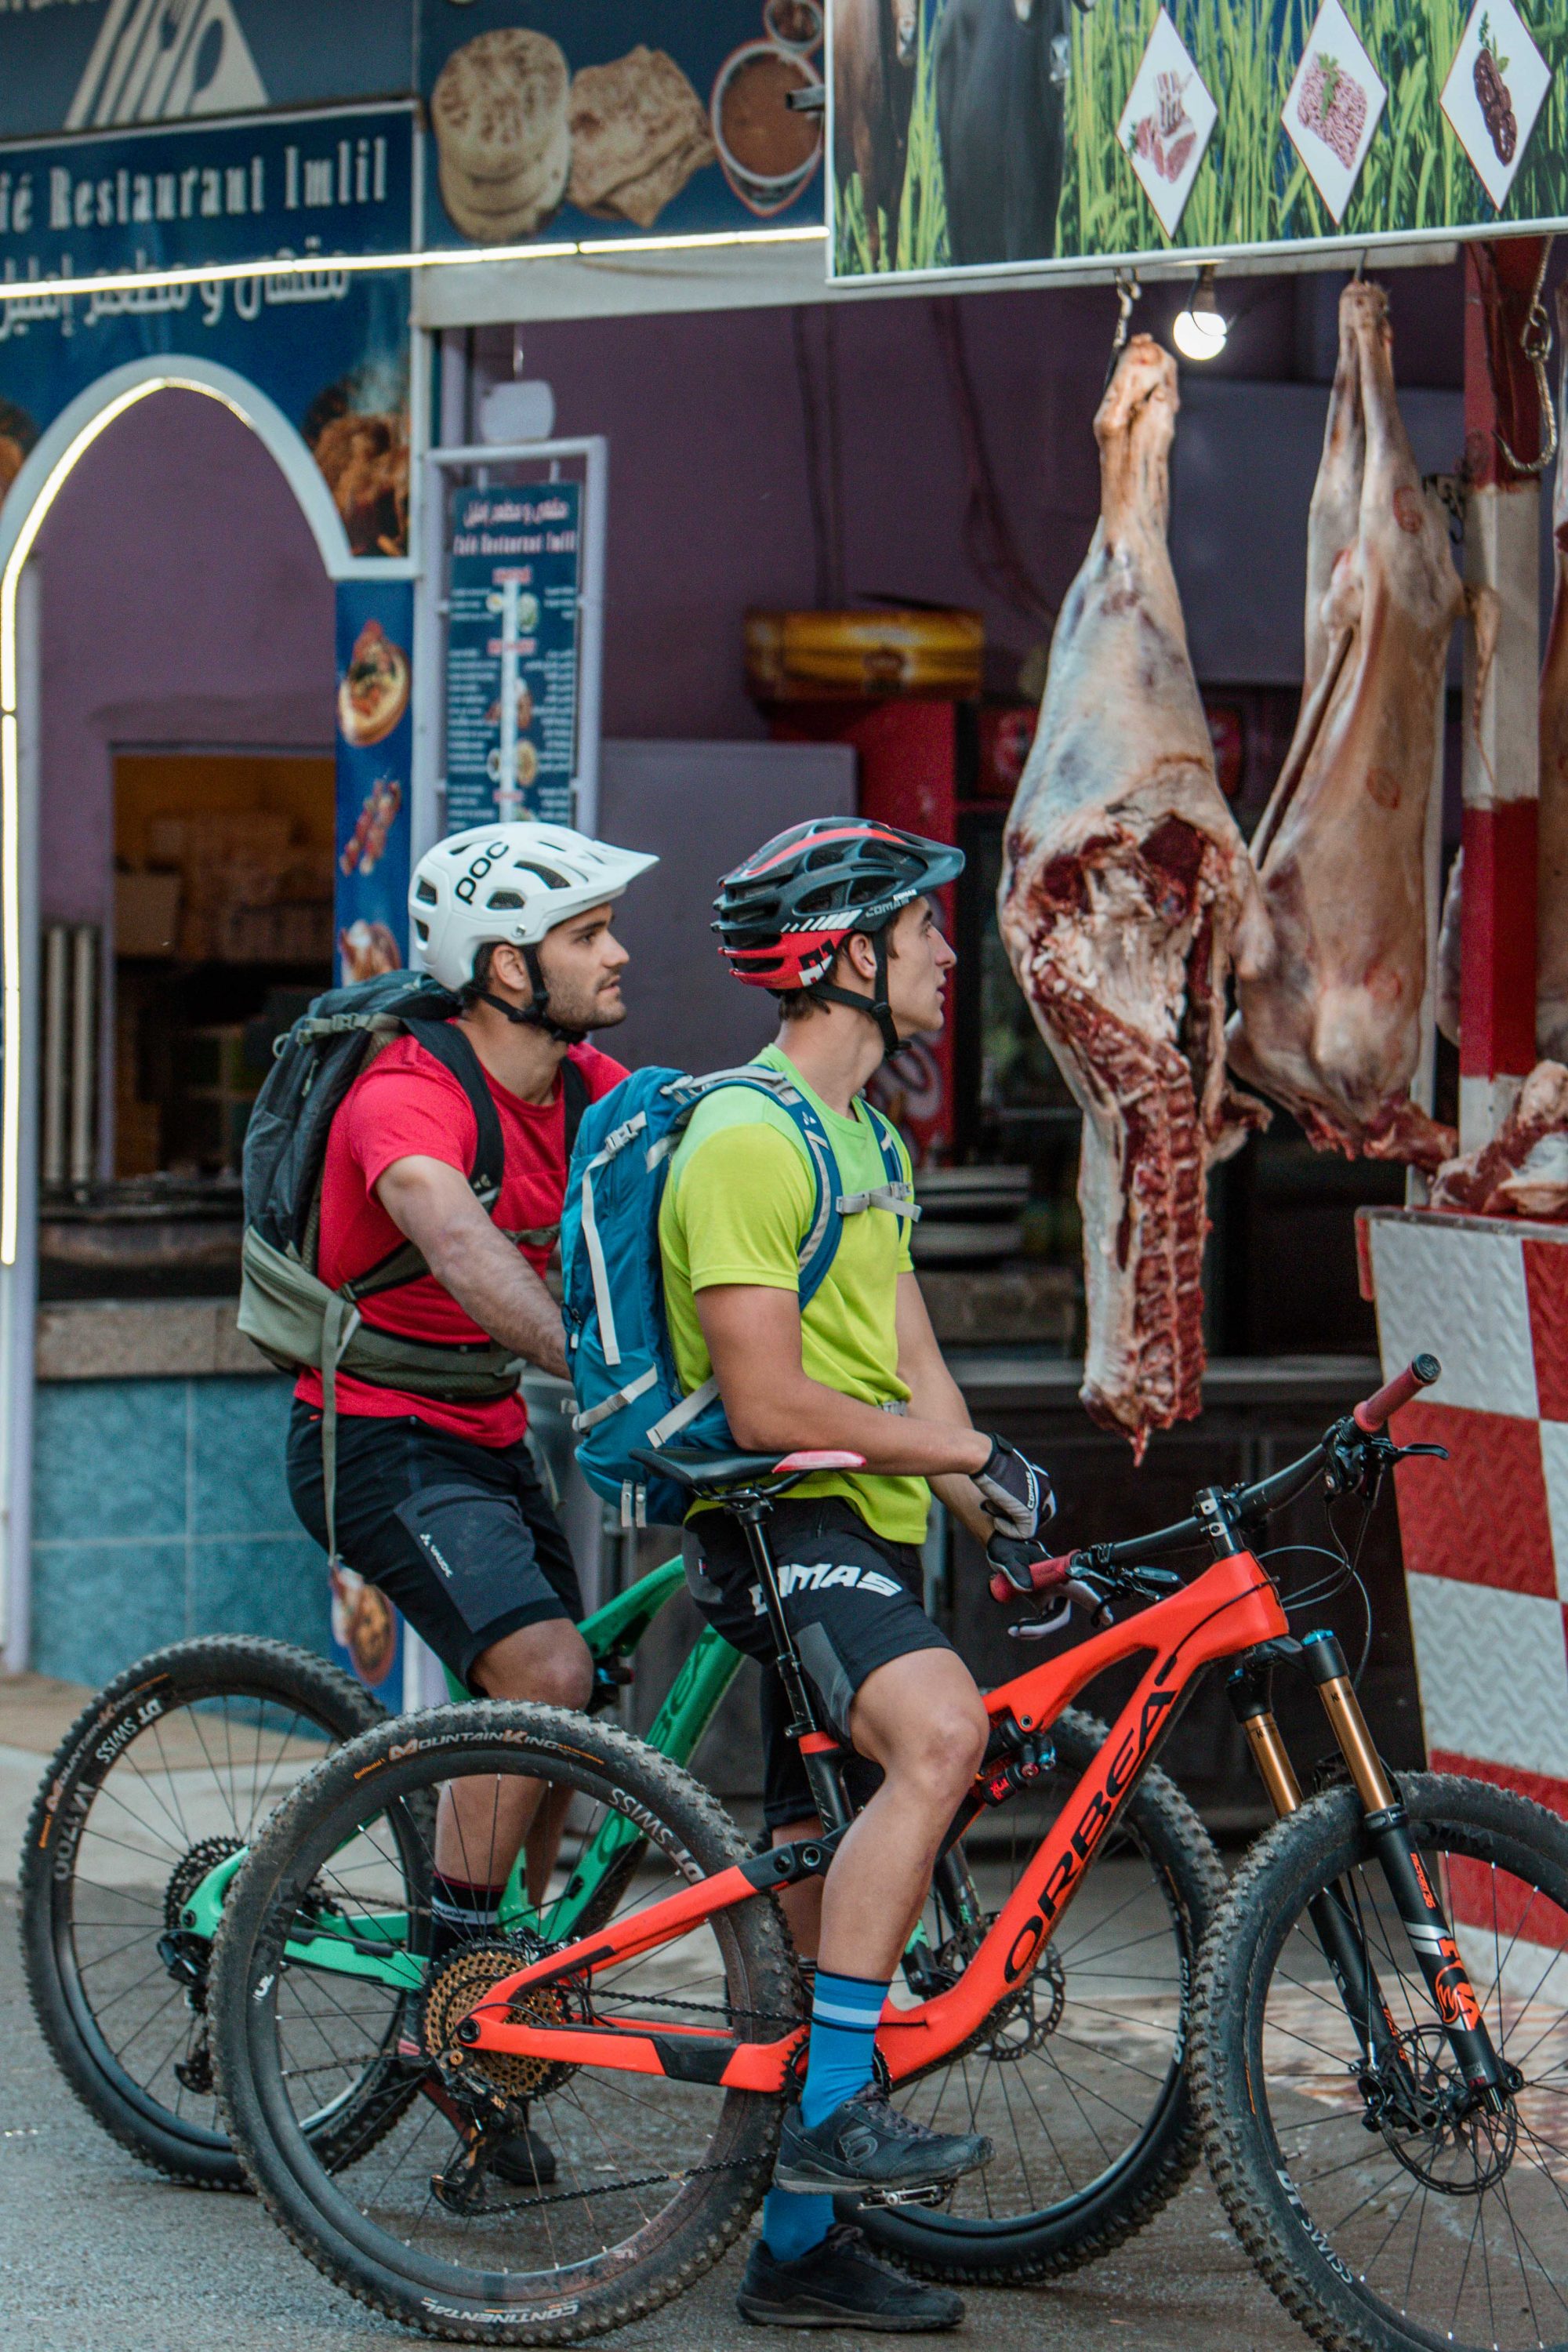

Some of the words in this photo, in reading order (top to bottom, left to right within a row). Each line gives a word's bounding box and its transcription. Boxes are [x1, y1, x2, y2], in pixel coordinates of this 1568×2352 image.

[49, 156, 266, 230] Restaurant
[285, 136, 387, 210] Imlil
[455, 841, 509, 906] POC
[95, 1716, 138, 1764] SWISS
[608, 1788, 674, 1845] SWISS
[1004, 1690, 1178, 1985] ORBEA
[1301, 2216, 1353, 2285] SWISS
[420, 2300, 580, 2324] CONTINENTAL
